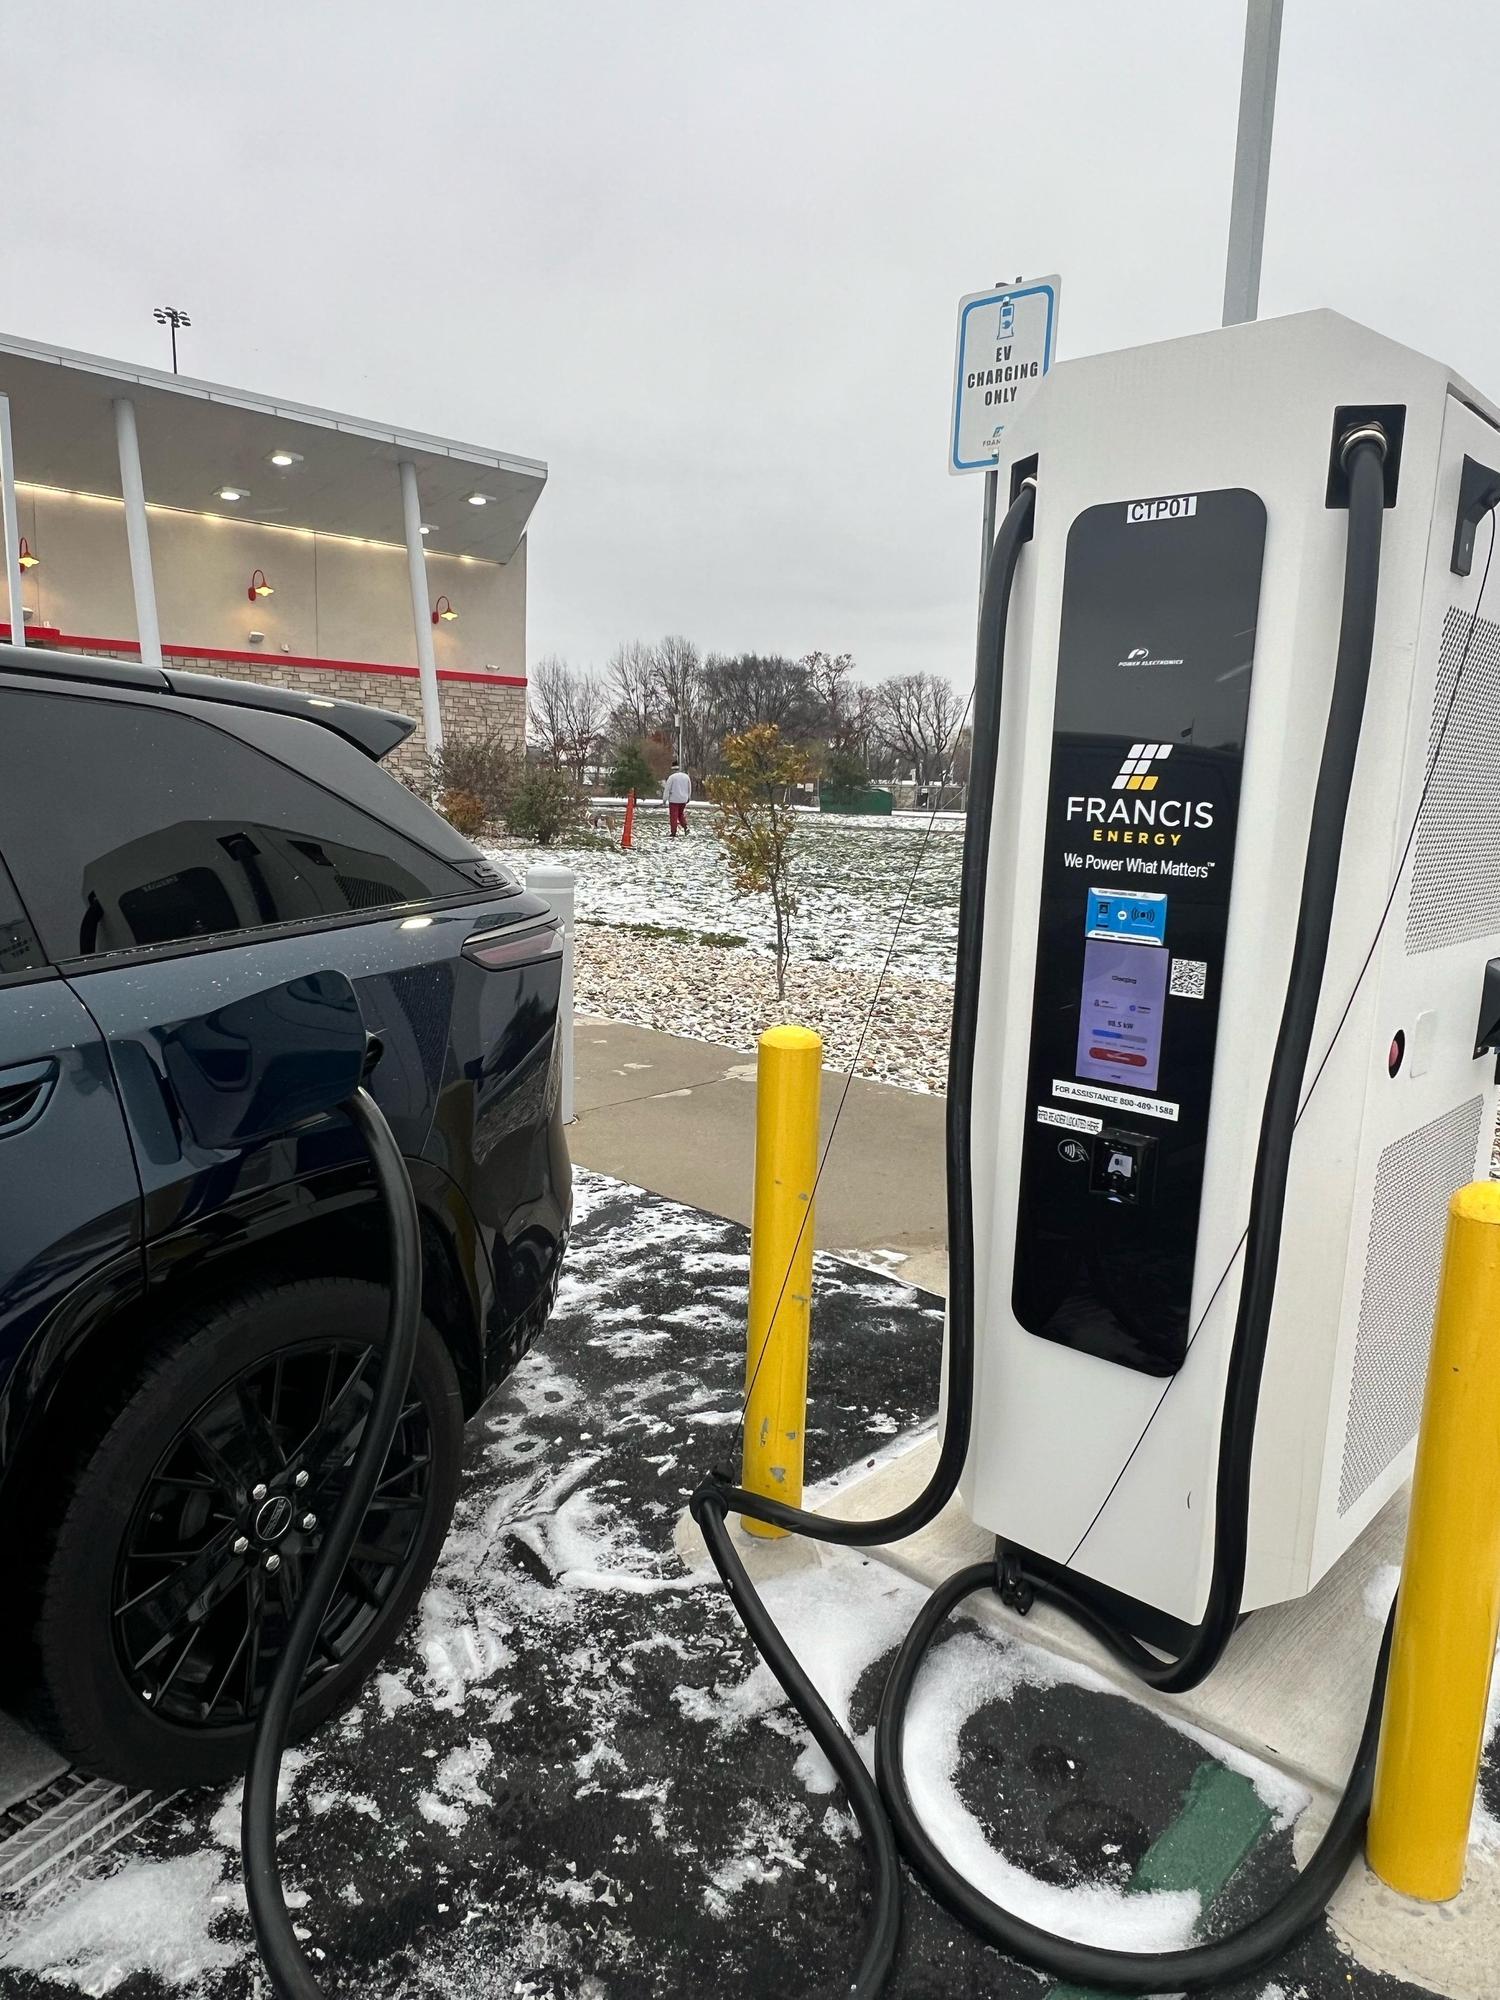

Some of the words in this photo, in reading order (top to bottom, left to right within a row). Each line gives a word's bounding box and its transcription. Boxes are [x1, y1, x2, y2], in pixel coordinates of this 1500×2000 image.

[995, 345, 1012, 362] EV
[967, 361, 1038, 389] CHARGING
[984, 386, 1018, 406] ONLY
[1131, 497, 1192, 521] CTP01
[1066, 796, 1214, 829] FRANCIS
[1092, 829, 1182, 846] ENERGY
[1063, 852, 1083, 868] We
[1085, 854, 1124, 871] Power
[1126, 857, 1158, 874] What
[1055, 1084, 1070, 1094] FOR
[1071, 1088, 1118, 1104] ASSISTANCE
